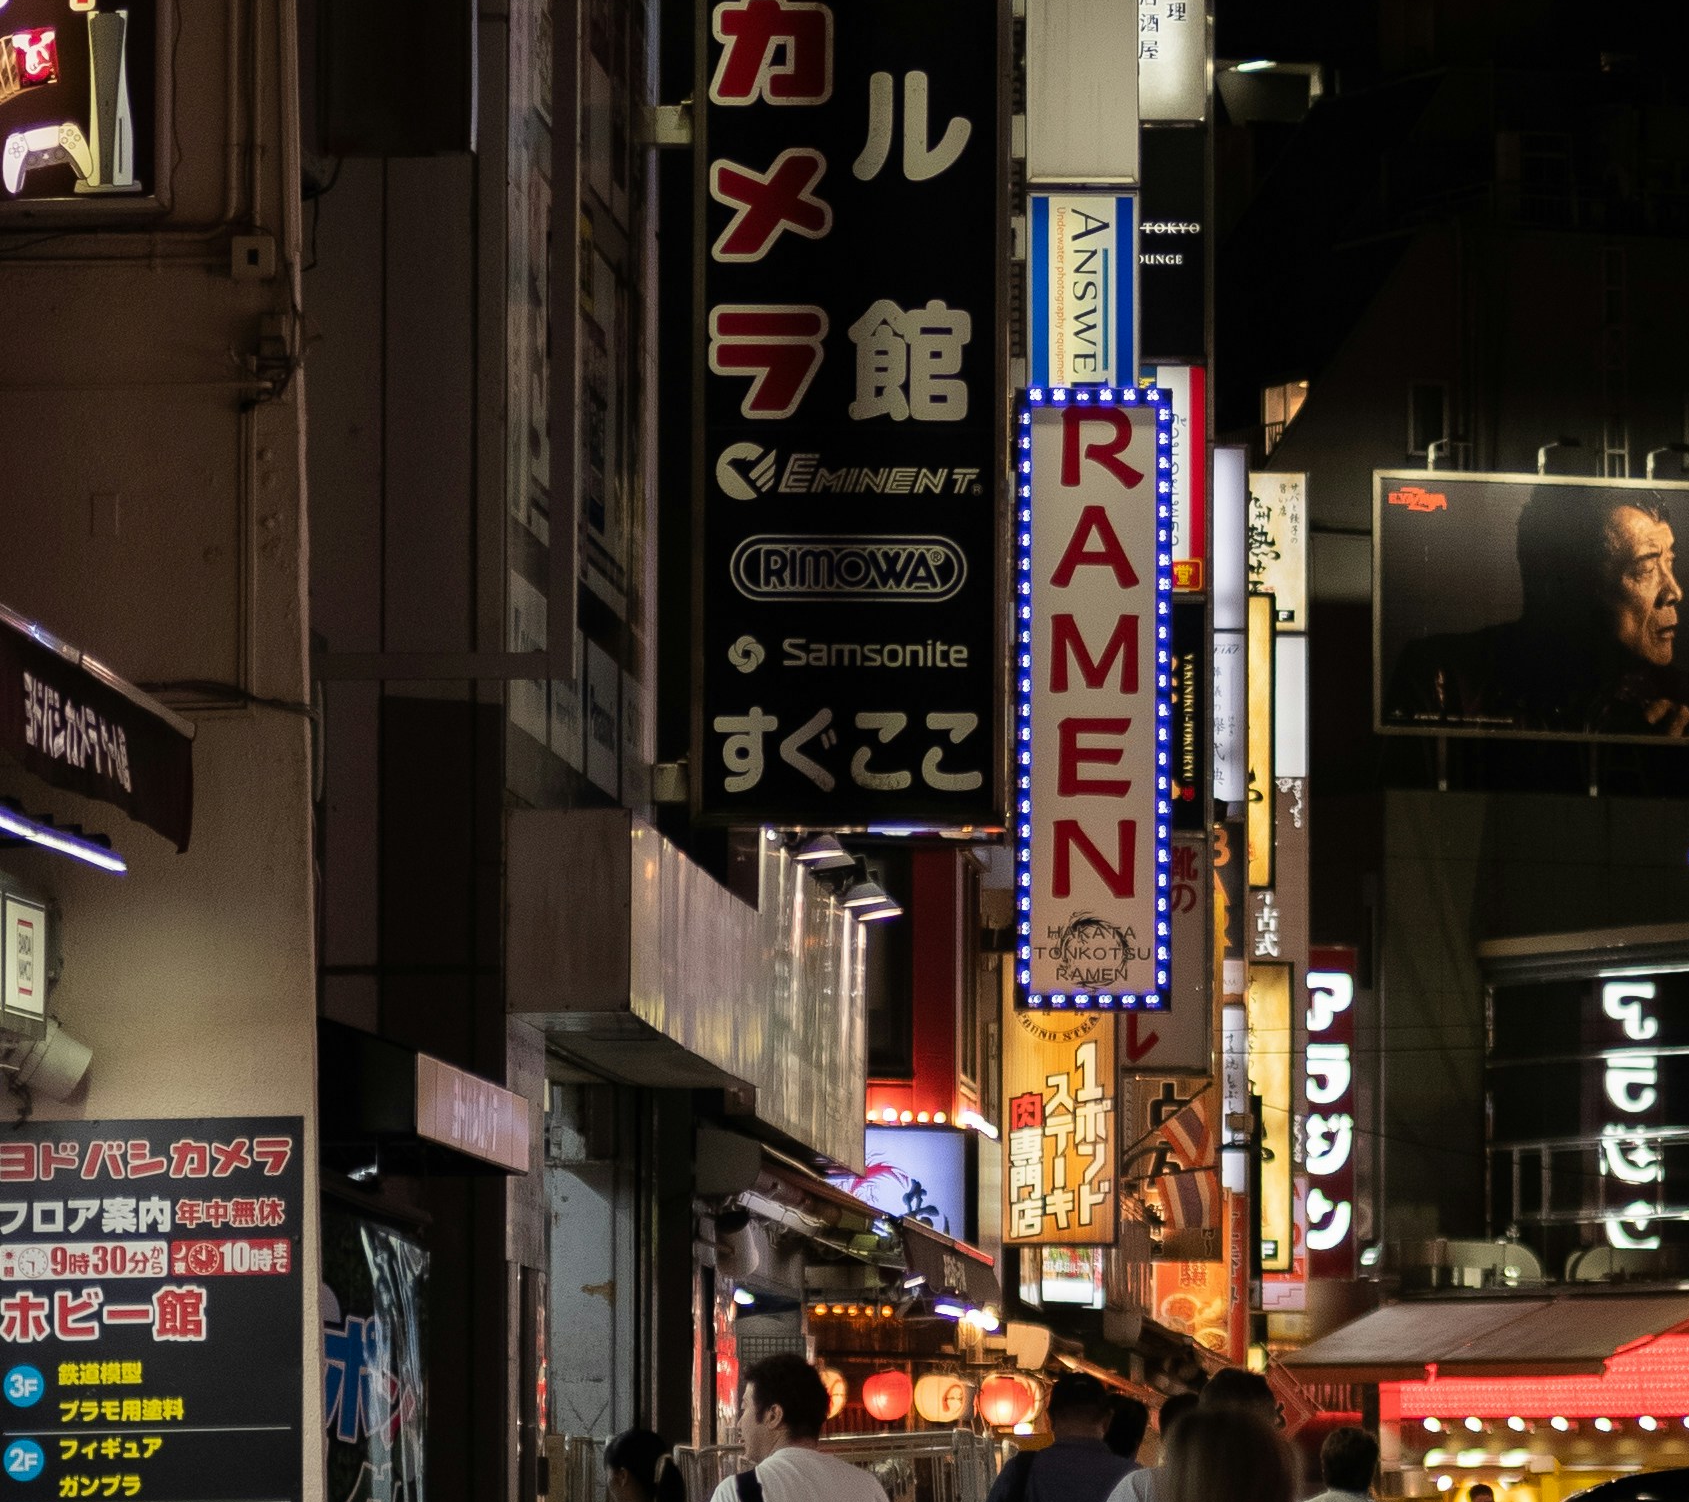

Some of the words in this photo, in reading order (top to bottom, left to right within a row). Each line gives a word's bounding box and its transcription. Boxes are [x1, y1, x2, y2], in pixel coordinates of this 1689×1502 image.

[1056, 206, 1067, 265] Underwater
[1054, 266, 1066, 332] photography
[1070, 207, 1110, 389] ANSWE
[777, 452, 981, 495] EMINENT
[760, 545, 943, 591] RIMOWA
[782, 637, 969, 668] Samsonite
[1049, 405, 1145, 899] RAMEN
[712, 705, 984, 794] すぐここ
[1033, 946, 1151, 962] TONKOTSU
[1046, 925, 1137, 941] HAKATA
[1055, 967, 1129, 982] RAMEN
[1043, 1072, 1075, 1231] ステーキ
[1074, 1040, 1112, 1227] 1ポンド
[0, 1137, 292, 1182] ヨドバシカメラ
[1008, 1091, 1044, 1239] 肉専門店
[0, 1195, 171, 1235] フロア案内
[175, 1197, 285, 1228] 年中無休
[0, 1285, 207, 1342] ホビー館
[9, 1372, 38, 1398] 3F
[58, 1360, 143, 1386] 鉄道模型
[59, 1396, 186, 1423] プラモ用塗料
[9, 1447, 38, 1473] 2F
[59, 1435, 163, 1460] フィギュア
[59, 1473, 142, 1498] ガンプラ
